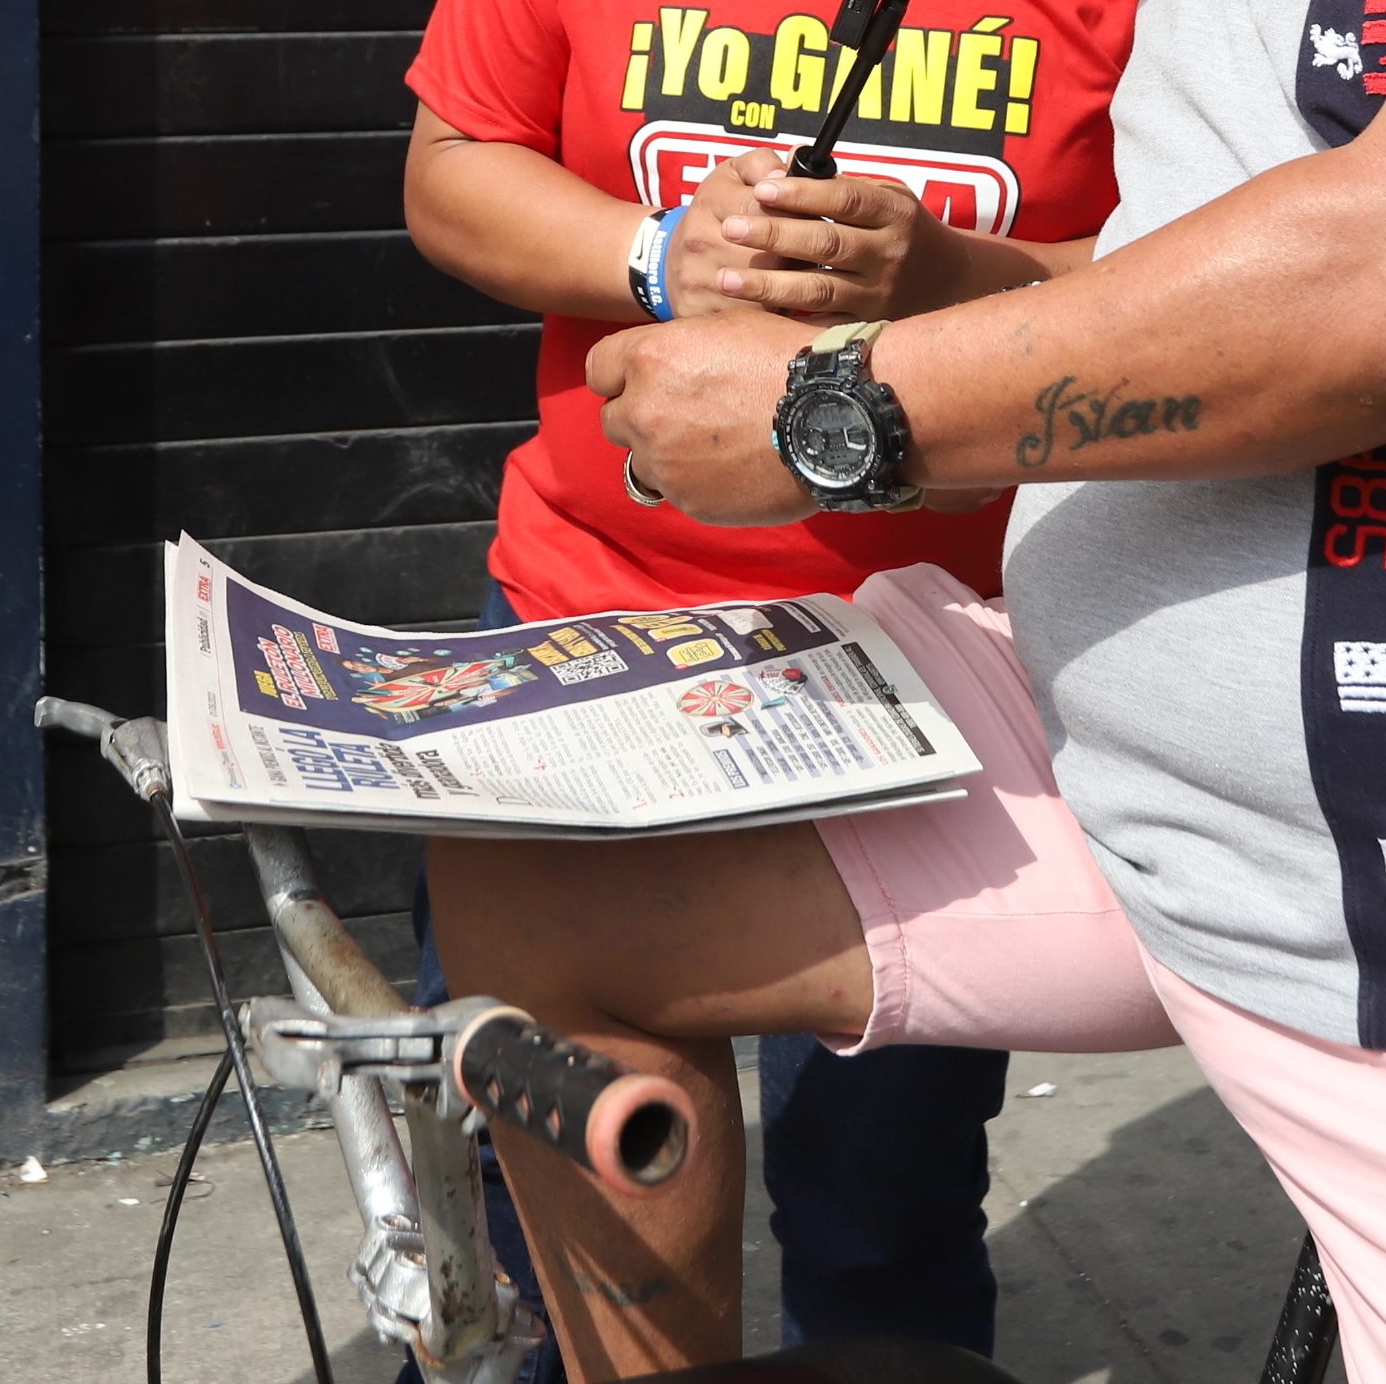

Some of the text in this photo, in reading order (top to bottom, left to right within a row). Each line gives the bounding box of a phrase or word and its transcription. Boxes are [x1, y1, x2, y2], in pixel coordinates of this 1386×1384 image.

[730, 101, 775, 130] CON
[647, 229, 668, 307] Astillero F.C.
[200, 558, 211, 568] 5
[198, 575, 210, 602] EXTRA
[199, 617, 211, 654] Publicidad
[314, 625, 336, 652] EXTRA
[257, 637, 305, 709] EL RULETÓN
[278, 626, 323, 698] MILLONARIO
[253, 670, 278, 698] JUEGA
[278, 727, 328, 761] LA
[275, 746, 354, 792] LLEGÓ
[329, 742, 401, 790] RULETA
[379, 743, 441, 800] más divertida
[416, 748, 480, 797] y ganadora
[715, 751, 747, 788] LOS PREMIOS
